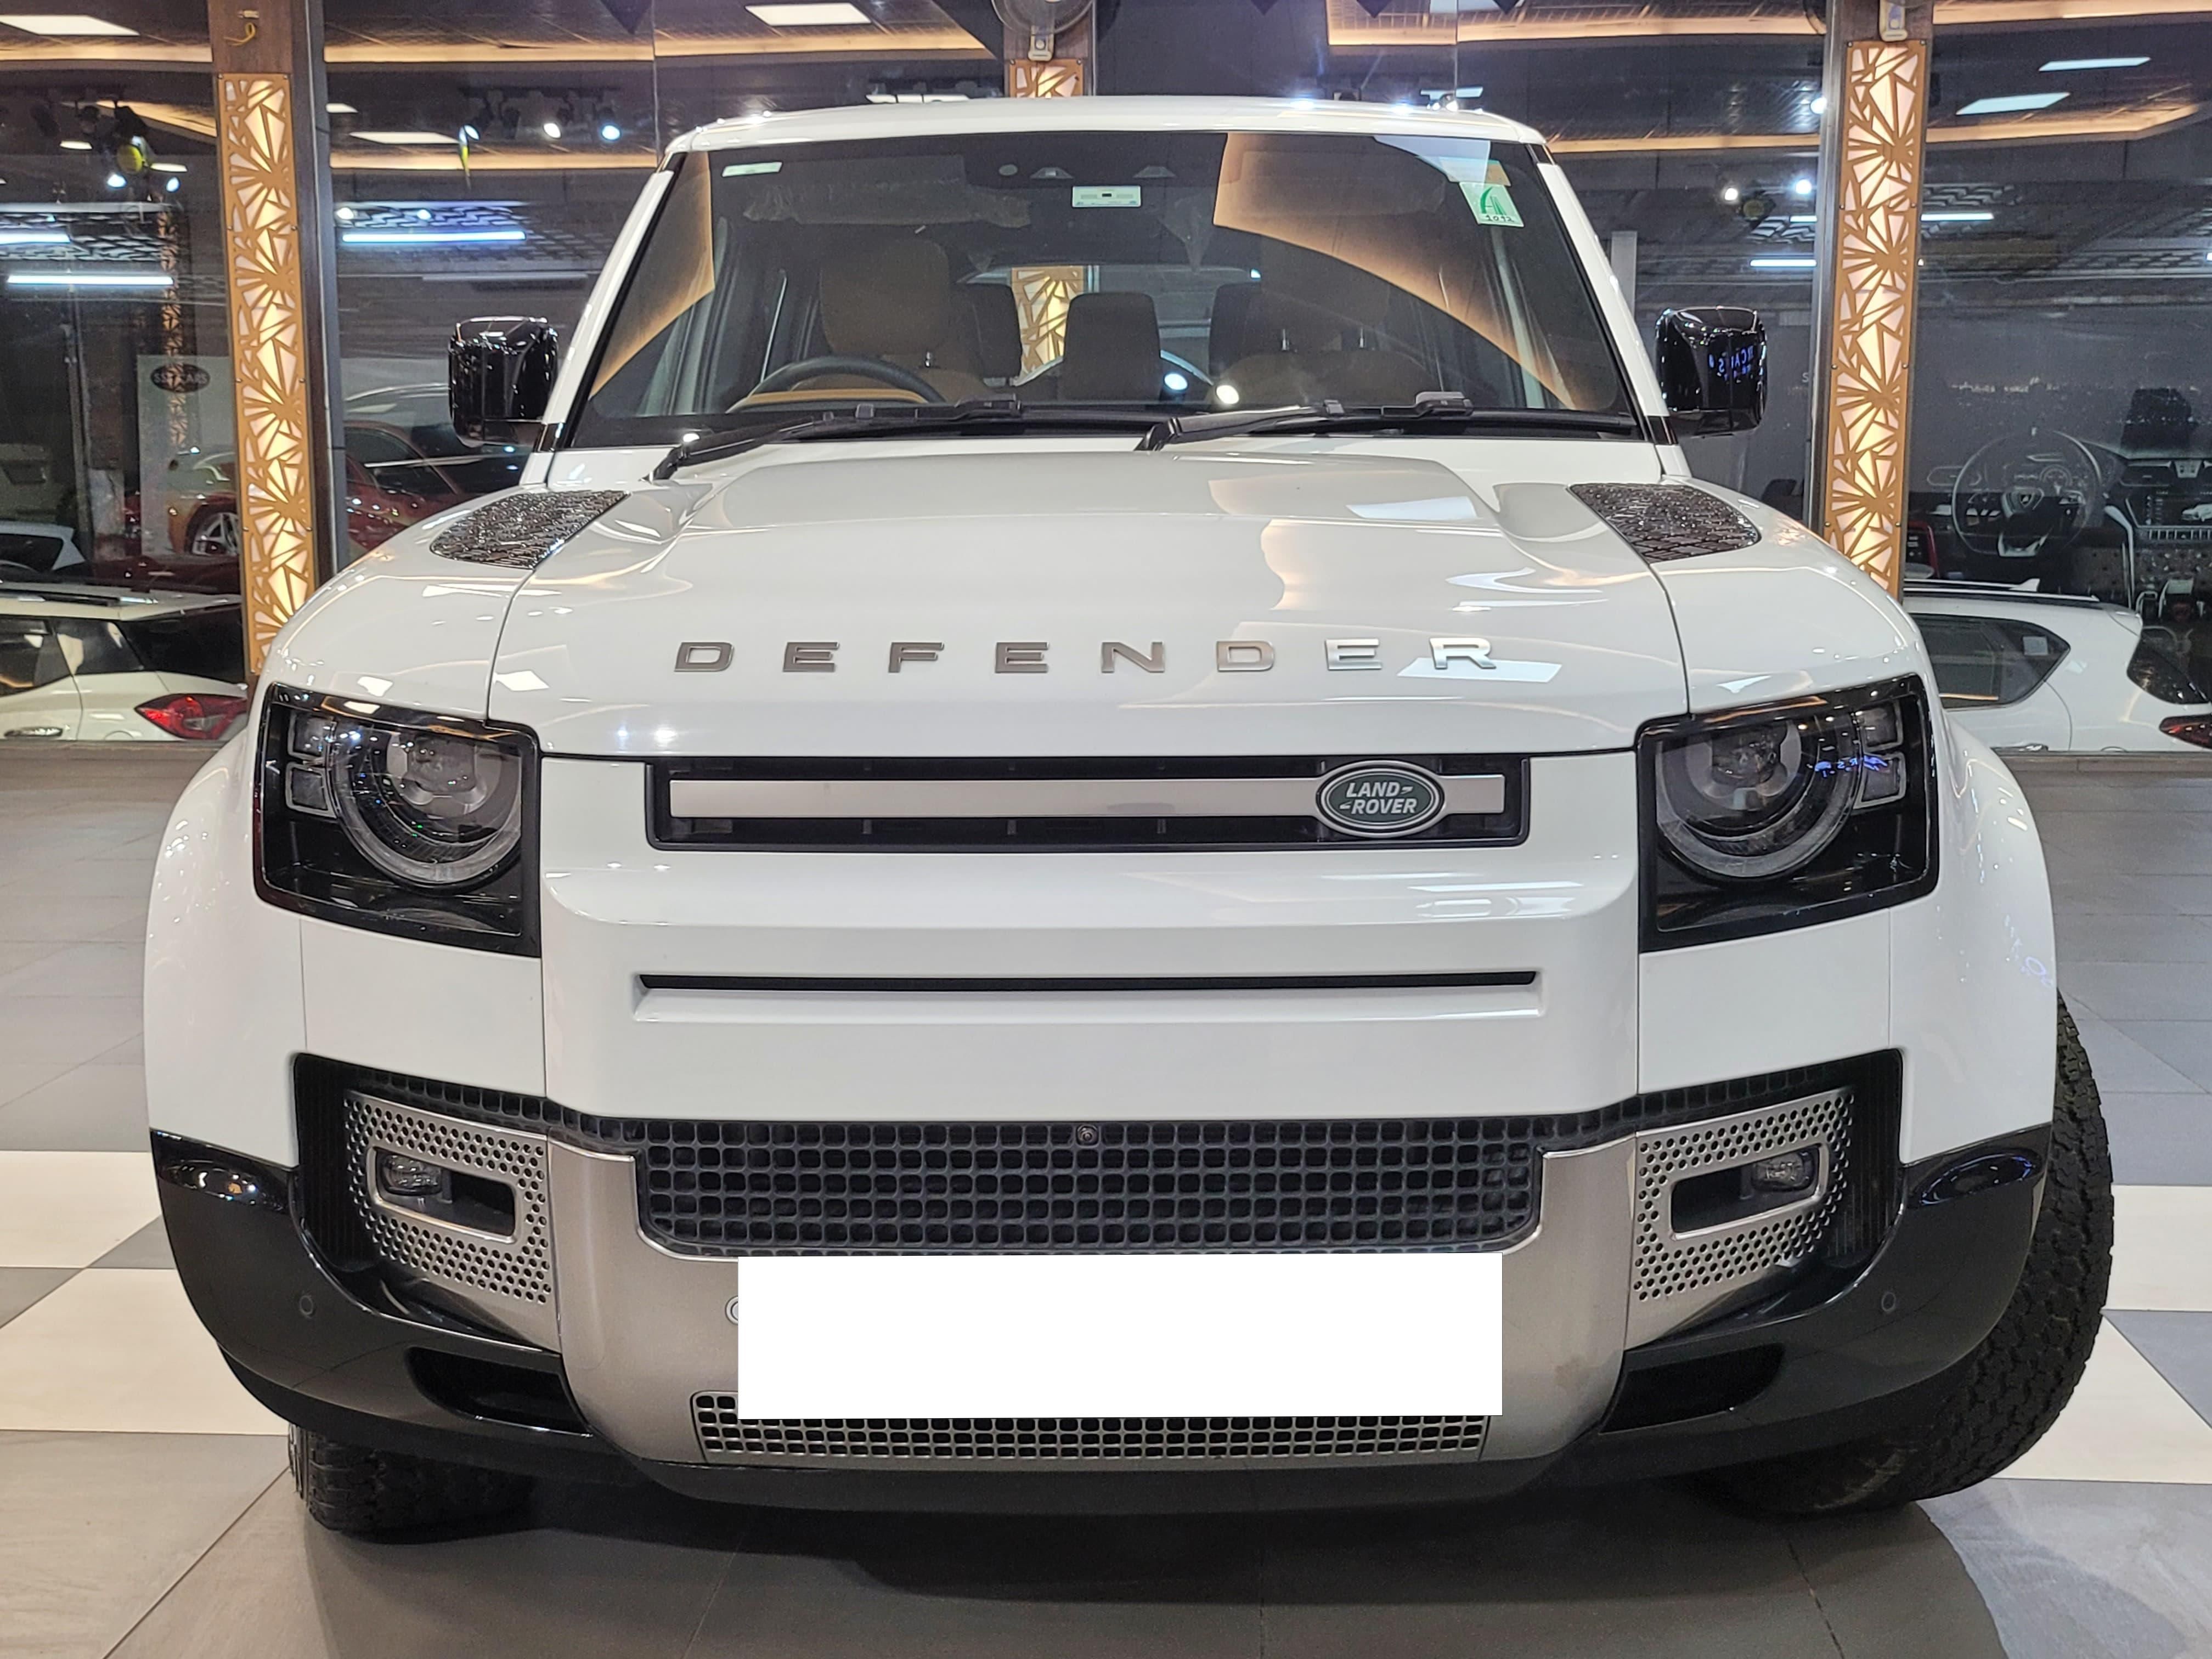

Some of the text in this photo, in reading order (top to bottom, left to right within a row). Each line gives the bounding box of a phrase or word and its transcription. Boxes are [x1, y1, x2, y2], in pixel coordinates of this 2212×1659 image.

[674, 637, 1497, 673] DEFENDER
[1346, 782, 1400, 798] LAND
[1351, 798, 1417, 814] ROVER
